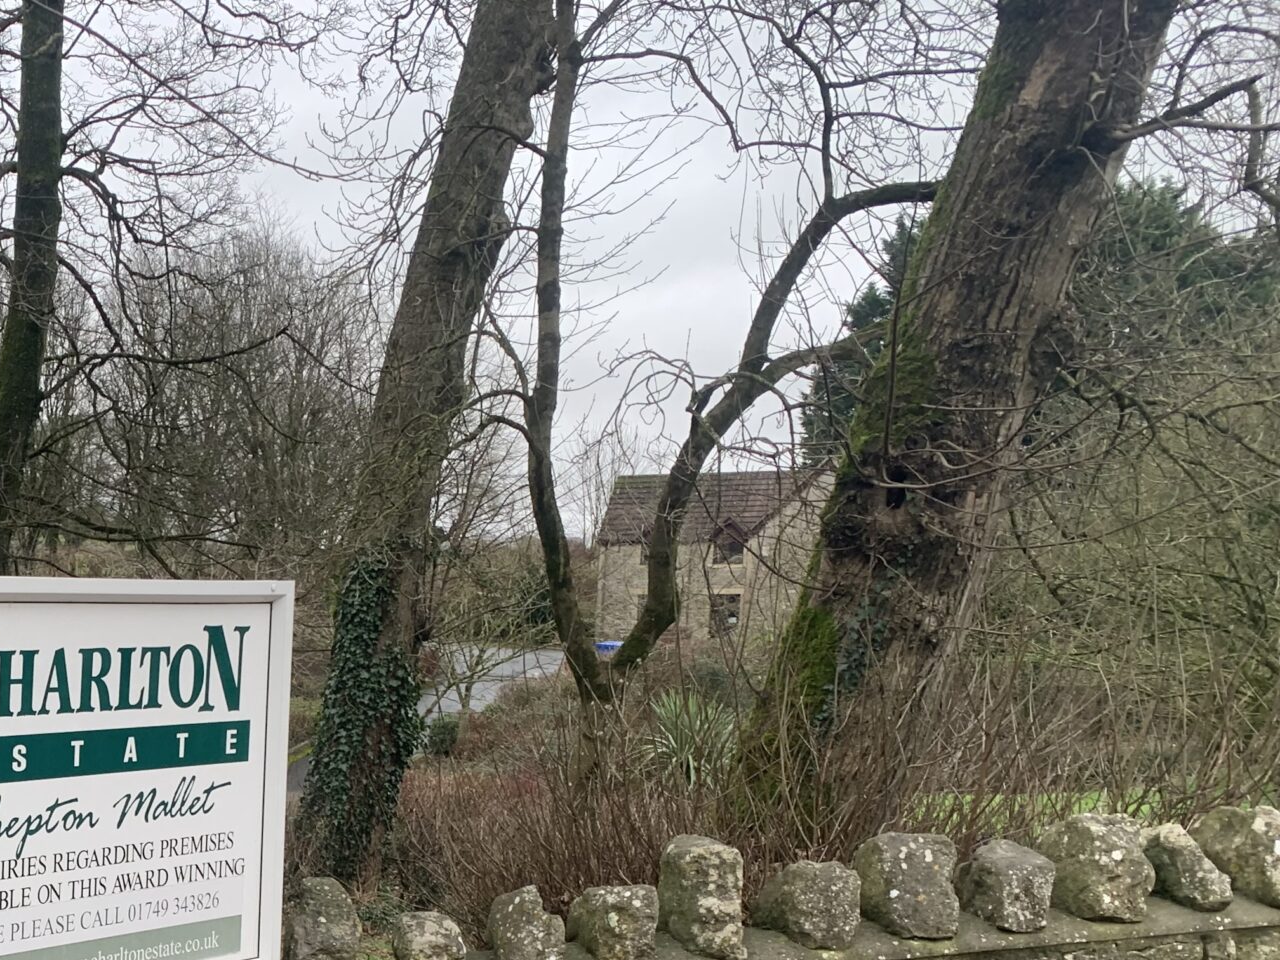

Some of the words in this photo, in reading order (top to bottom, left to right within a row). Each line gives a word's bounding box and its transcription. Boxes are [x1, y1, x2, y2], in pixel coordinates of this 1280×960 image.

[112, 776, 232, 828] Mallet
[52, 843, 154, 873] REGARDING
[160, 831, 235, 860] PREMISES
[37, 886, 62, 905] ON
[68, 877, 107, 900] THIS
[112, 868, 169, 893] AWARD
[174, 858, 246, 884] WINNING
[10, 916, 76, 942] PLEASE
[80, 906, 124, 931] CALL
[128, 899, 168, 923] 01749
[172, 891, 220, 915] 343826
